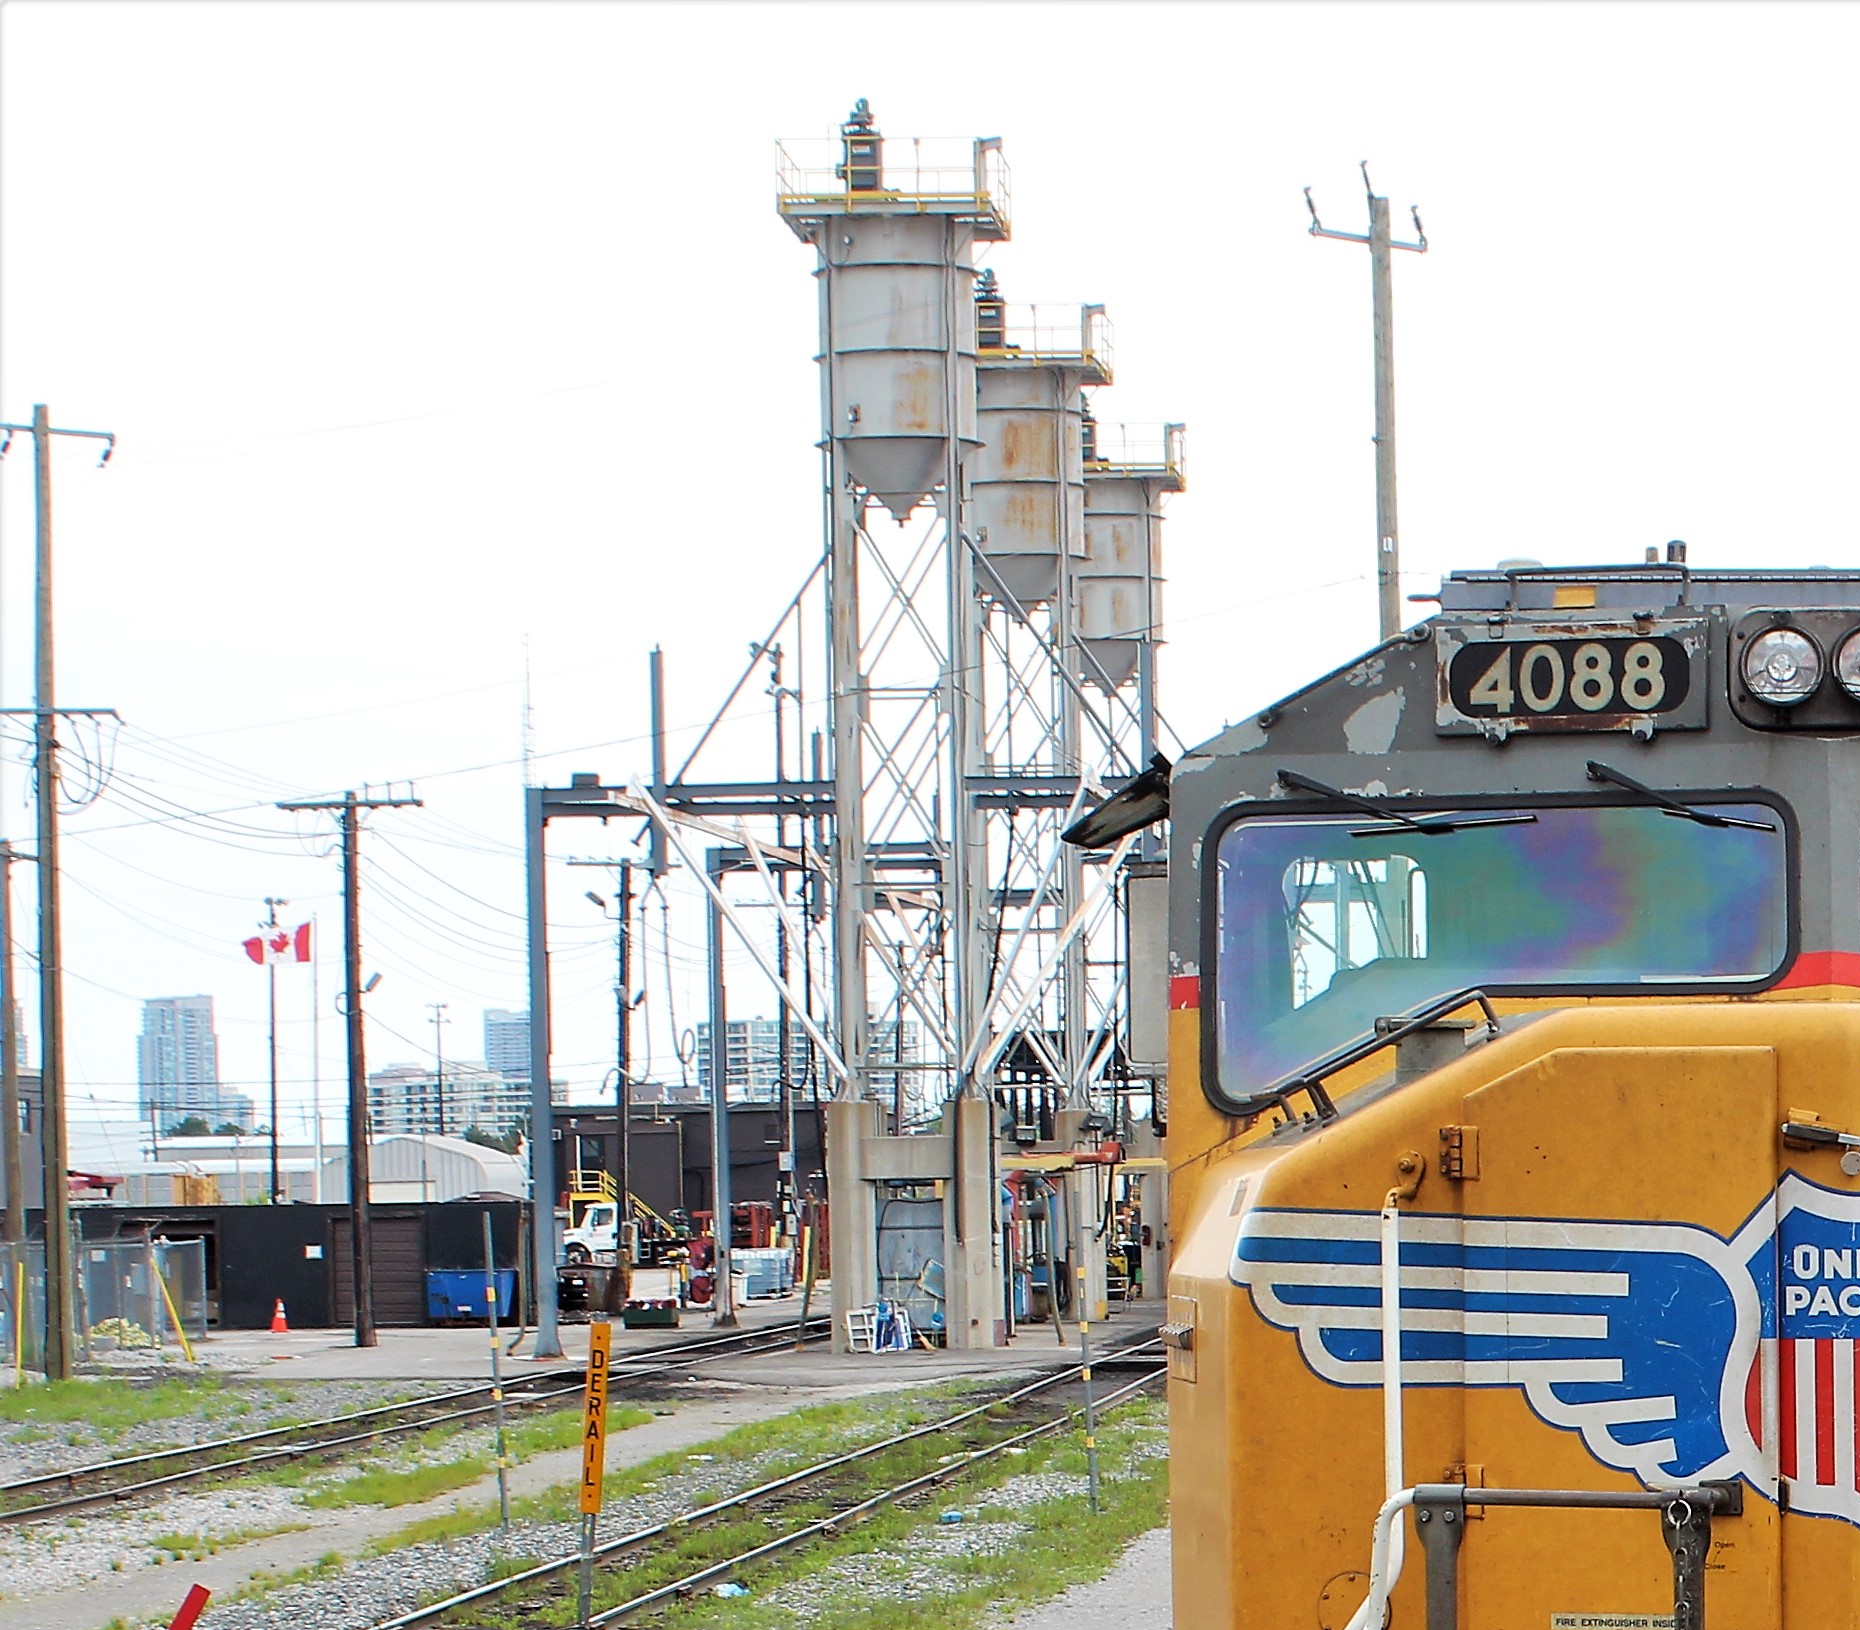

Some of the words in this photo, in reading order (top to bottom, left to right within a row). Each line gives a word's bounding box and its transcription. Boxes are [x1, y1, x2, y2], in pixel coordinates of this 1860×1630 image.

[1469, 641, 1666, 714] 4088
[585, 1349, 605, 1487] DERAIL
[1556, 1618, 1577, 1627] FIRE
[1581, 1618, 1648, 1628] EXTINGUISHER
[1652, 1620, 1677, 1629] INSID
